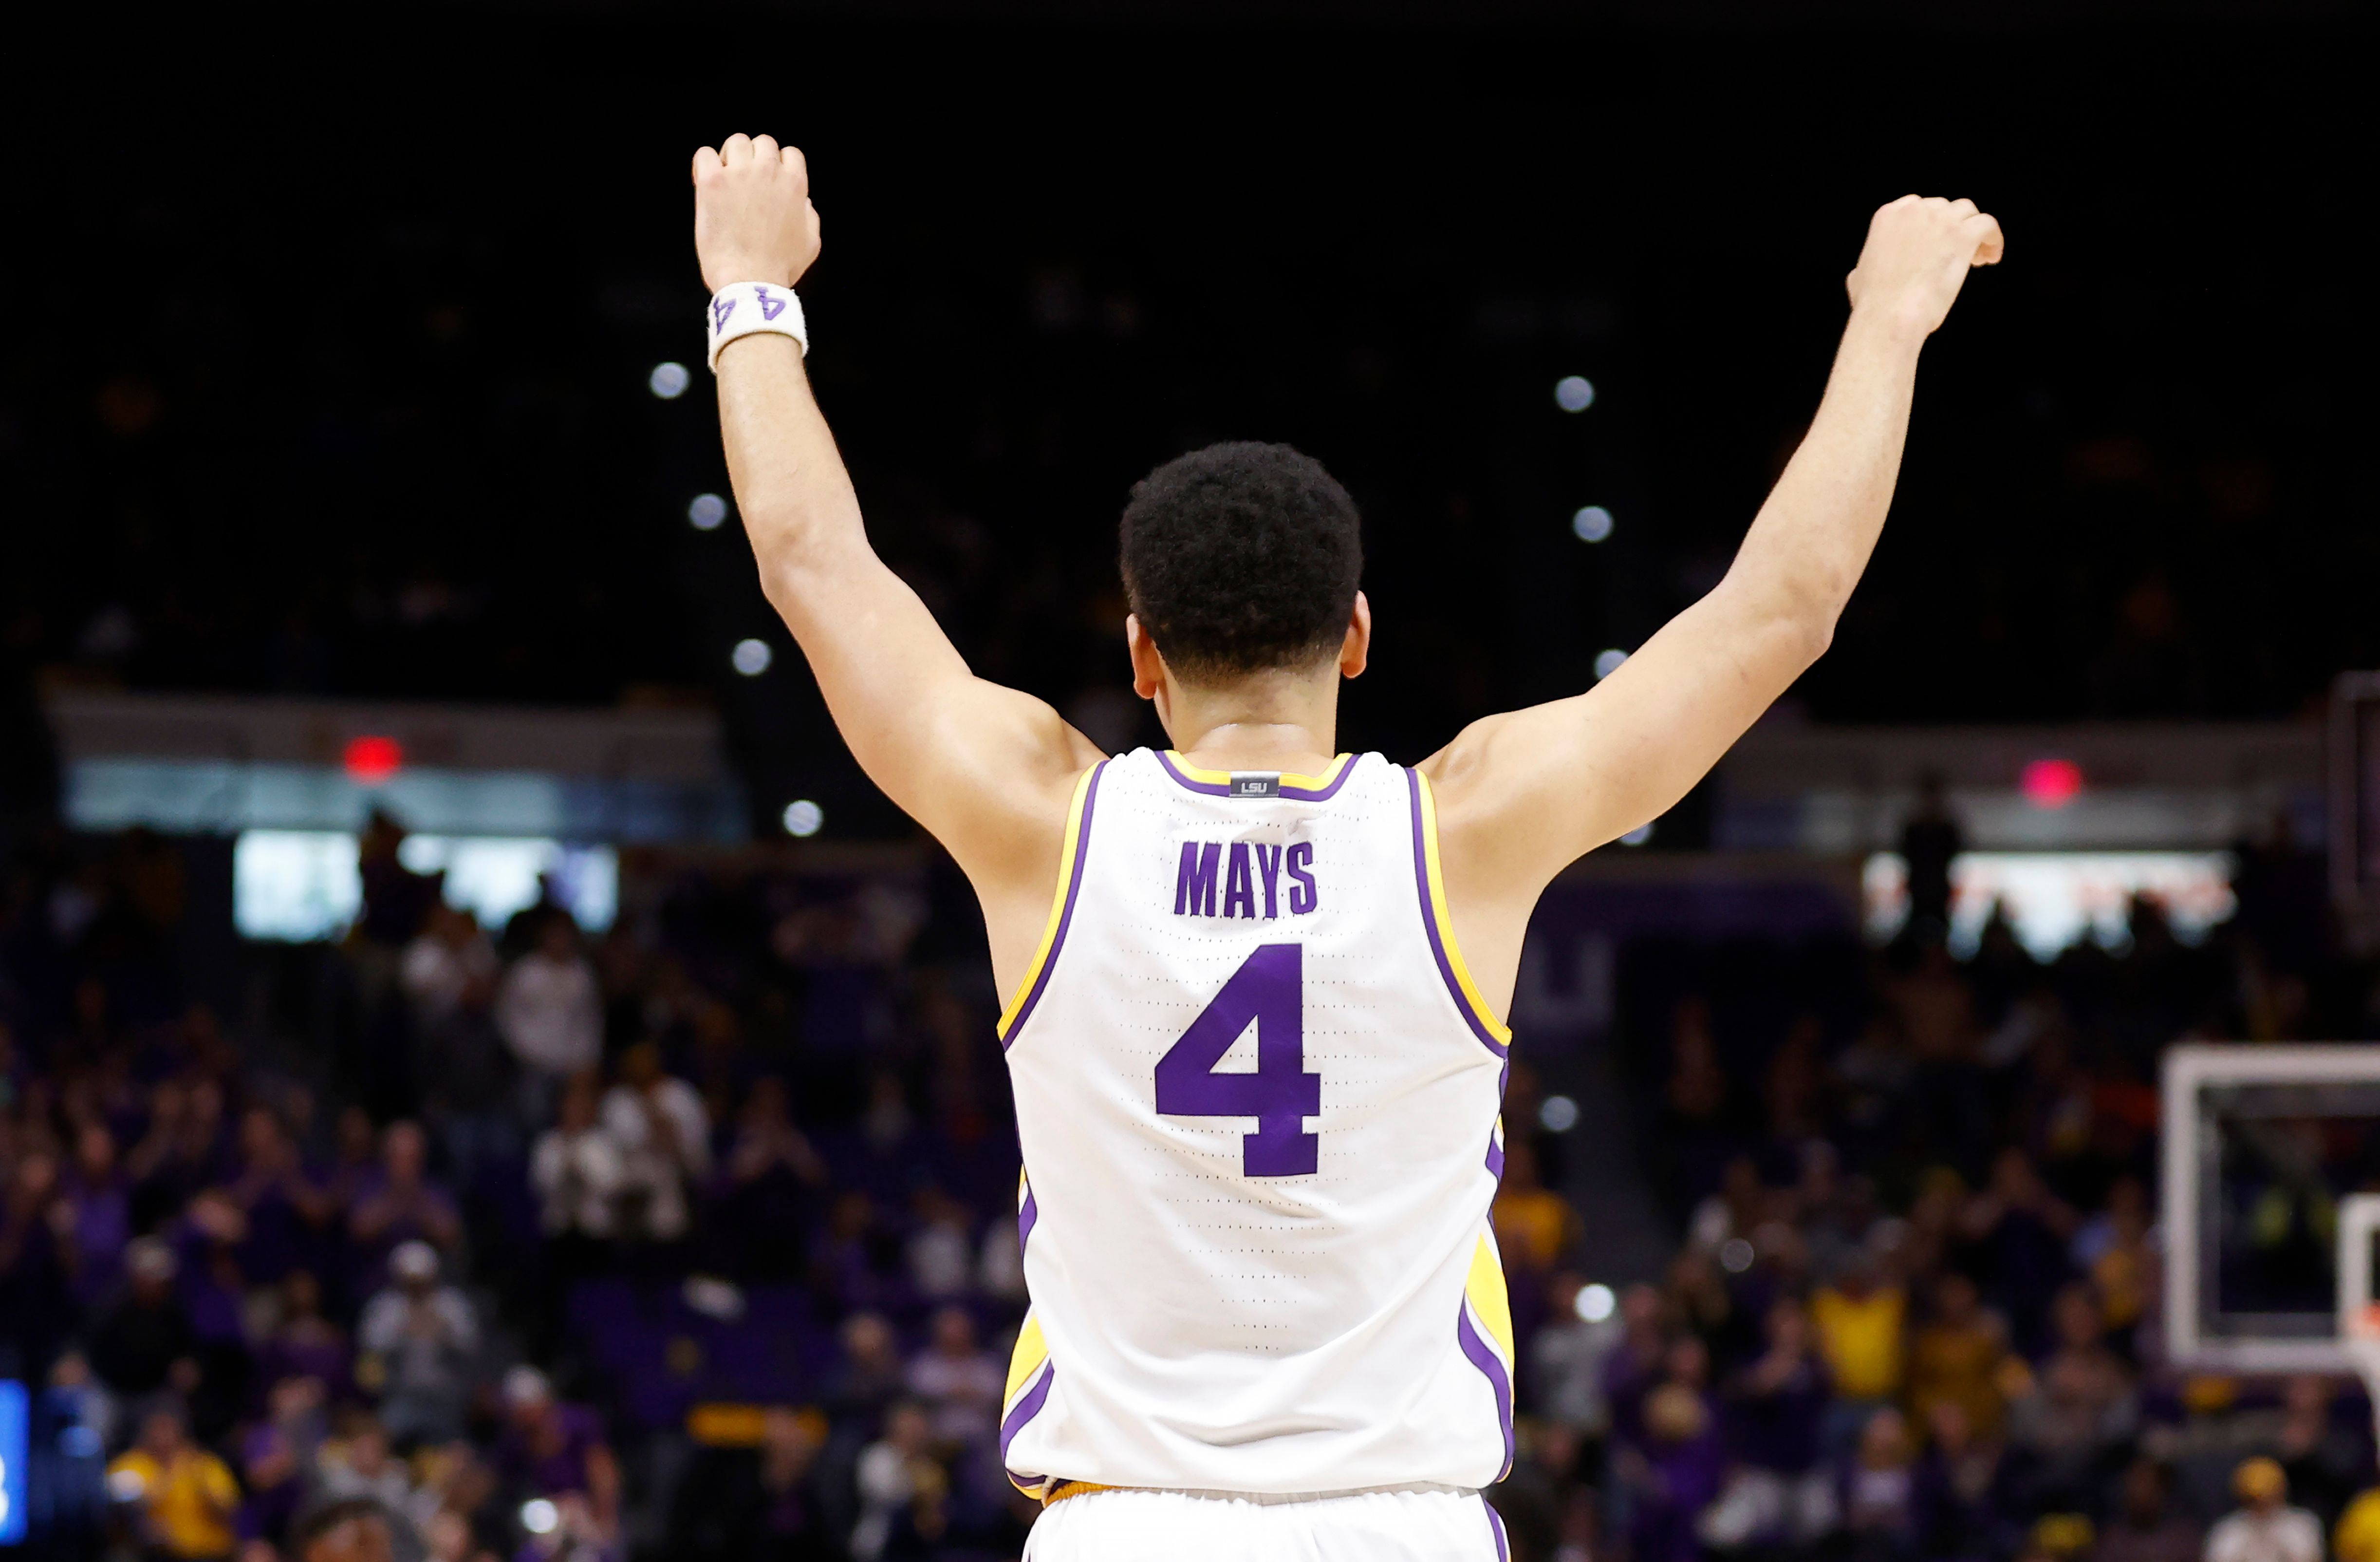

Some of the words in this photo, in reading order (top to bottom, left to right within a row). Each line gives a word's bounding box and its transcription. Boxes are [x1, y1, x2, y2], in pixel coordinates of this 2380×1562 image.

[1240, 782, 1268, 794] LSU
[1174, 840, 1318, 919] MAYS
[1154, 943, 1320, 1177] 4
